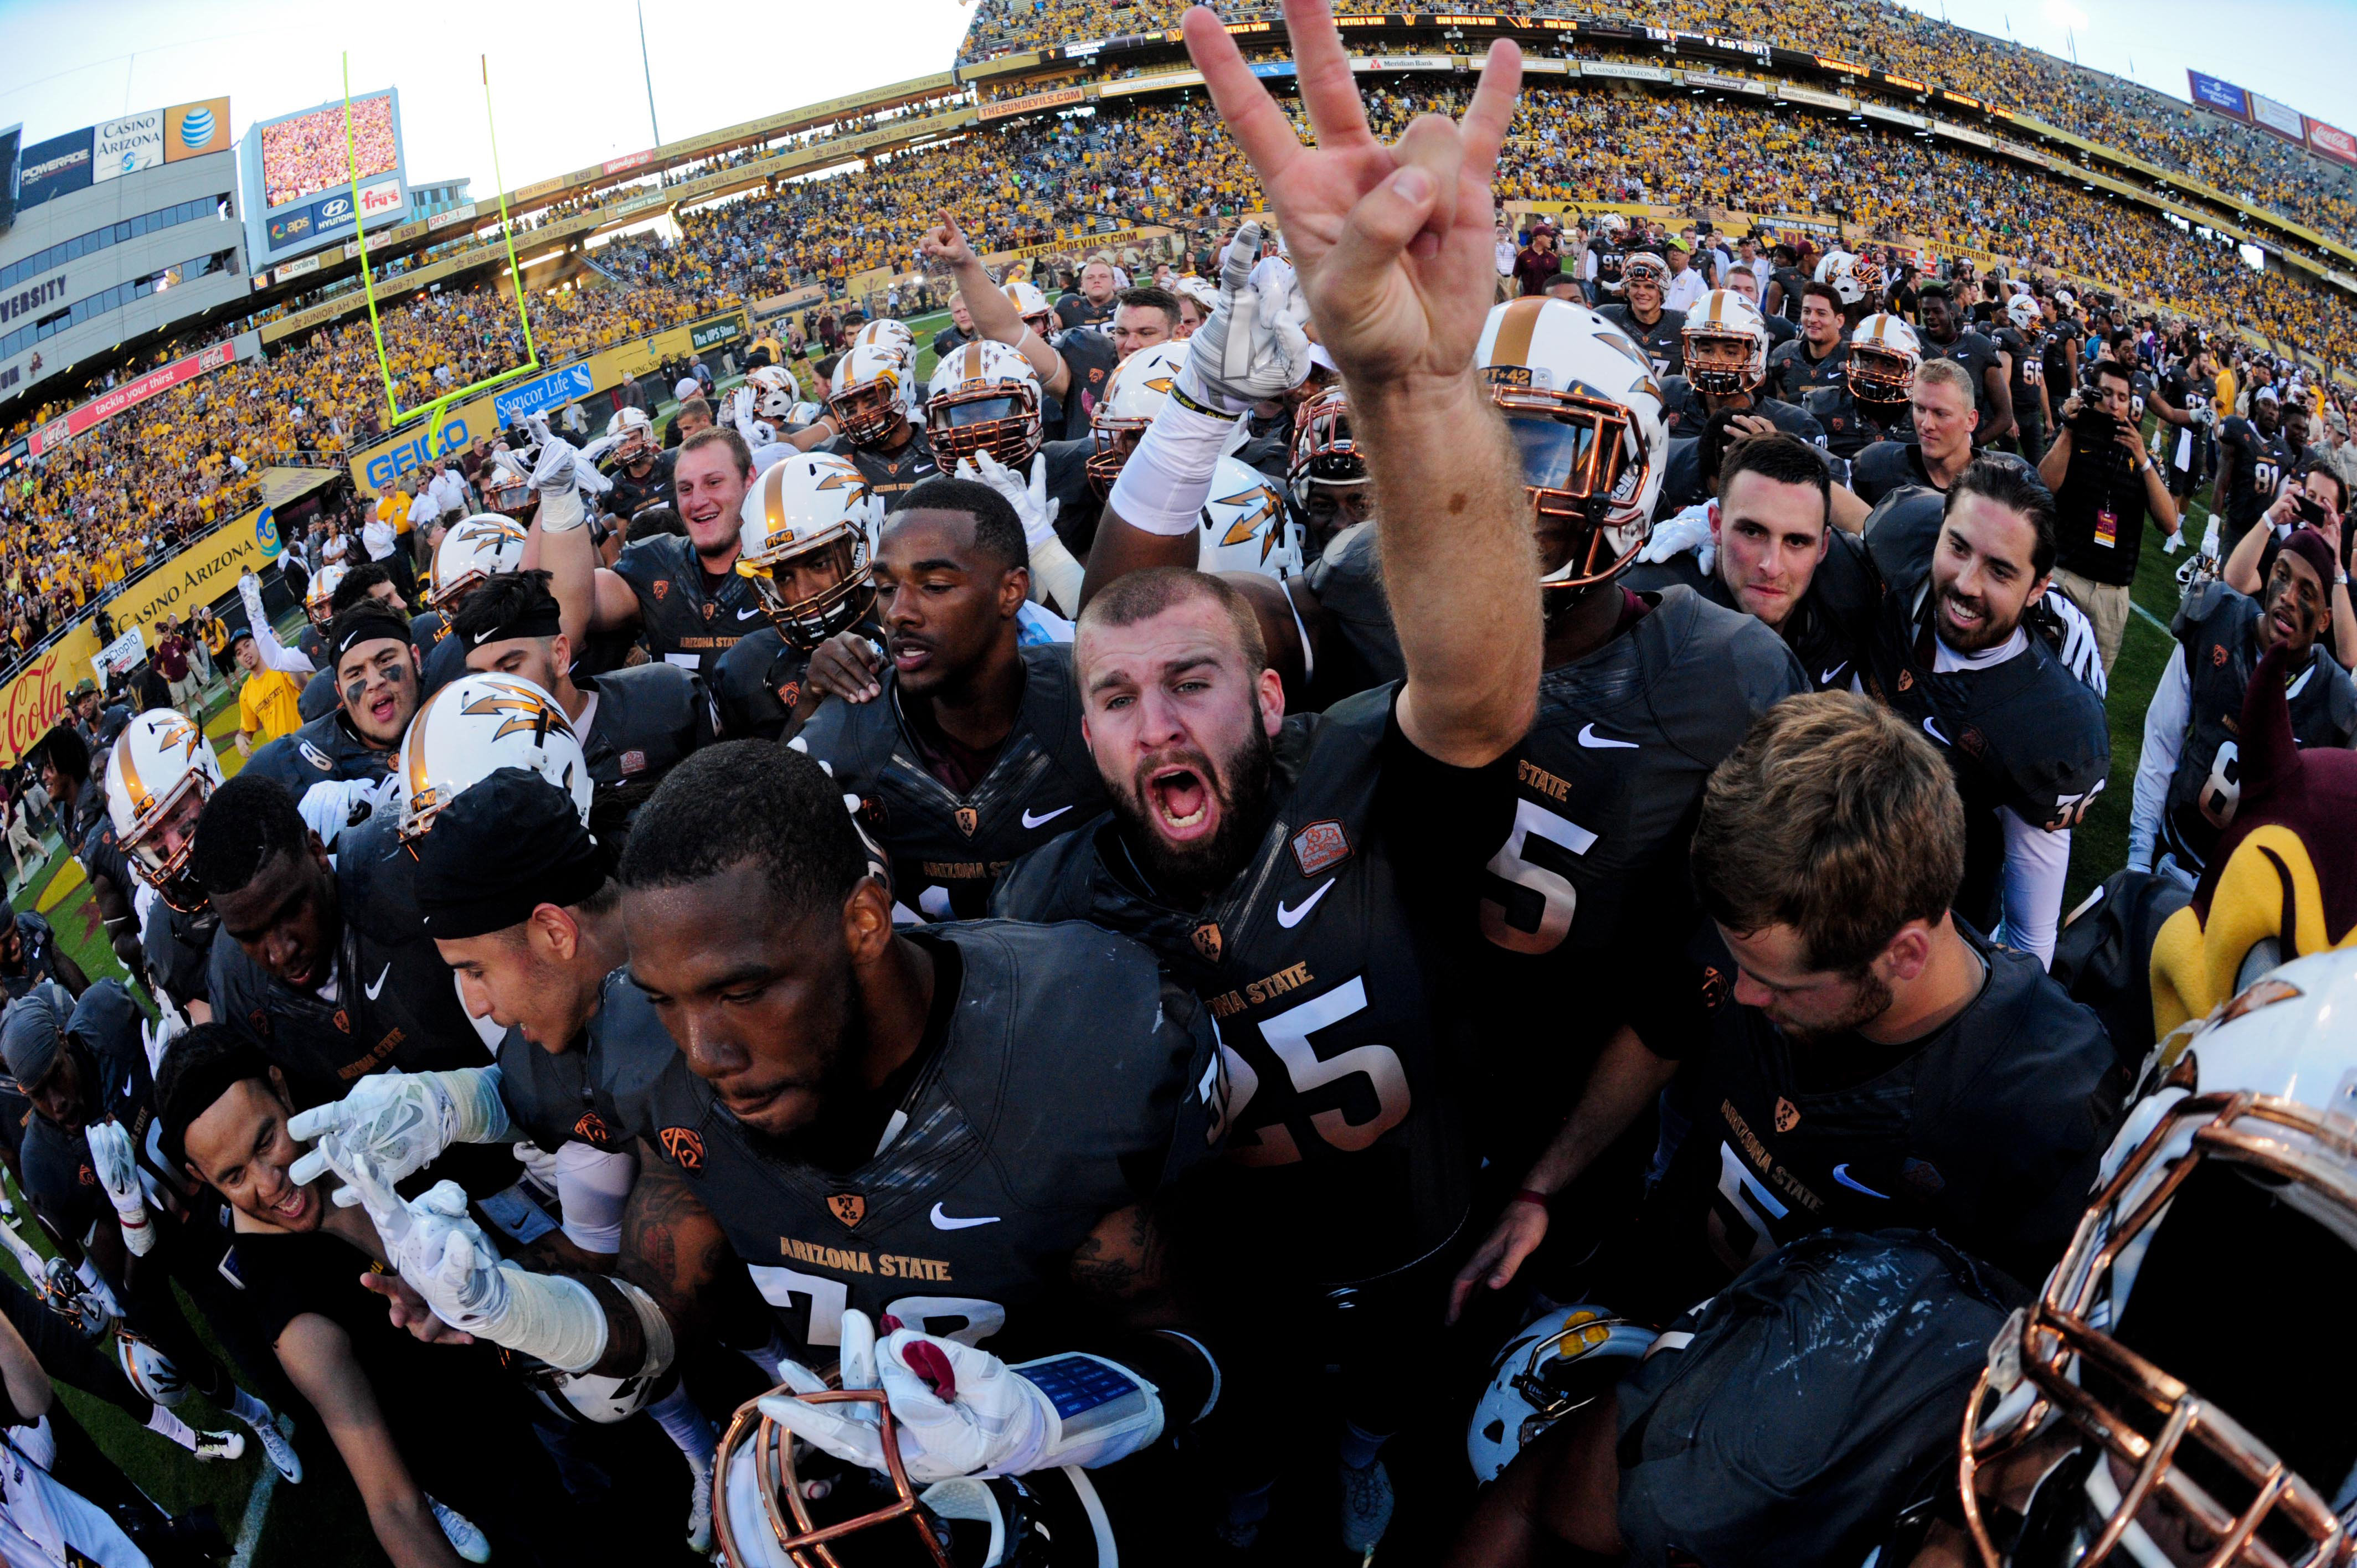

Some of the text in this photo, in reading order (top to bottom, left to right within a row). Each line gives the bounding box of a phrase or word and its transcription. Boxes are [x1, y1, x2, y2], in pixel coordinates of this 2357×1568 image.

[1250, 22, 1270, 32] WIN!
[1435, 16, 1496, 25] SUN DEVILS WIN!
[1544, 20, 1558, 29] SUN
[1066, 41, 1105, 52] COLORADO
[1718, 39, 1736, 49] 0:00
[1584, 64, 1659, 79] CASINO ARIZONA
[865, 85, 911, 99] RICHARDSON
[1130, 79, 1176, 89] bluemedia
[1686, 75, 1742, 89] ValleyMetro.org
[981, 90, 1080, 118] THESUNDEVILS.COM
[1780, 89, 1830, 104] midfirst.com/asu
[104, 117, 155, 138] CASINO
[770, 114, 796, 125] HARRIS
[97, 132, 160, 157] ARIZONA
[662, 145, 681, 154] LEON
[683, 137, 711, 149] BURTON
[826, 121, 942, 154] JIM JEFFCOAT 1979-82
[21, 148, 90, 182] POWERADE
[607, 157, 635, 173] Wendy's
[574, 171, 591, 183] ASU
[697, 161, 780, 190] JD HILL 1967-70
[534, 179, 560, 193] TICKETS?
[361, 190, 399, 210] fry's
[287, 216, 310, 233] aps
[318, 211, 355, 229] HYUNDAI
[400, 227, 416, 240] ASU
[467, 222, 579, 265] BOB BRENIG 1972-74
[1018, 231, 1138, 259] THESUDEVILS.COM
[279, 257, 317, 276] ASU online
[303, 307, 334, 324] JUNIOR
[337, 301, 350, 312] AH
[382, 278, 415, 298] 1969-71
[693, 325, 736, 346] The UPS Store
[198, 347, 224, 371] Coca-Cola
[2023, 360, 2044, 386] 66
[95, 371, 174, 415] tackle your thirst
[496, 372, 569, 419] Sagicor Life
[1180, 396, 1196, 411] devil
[41, 419, 70, 450] Coca-Cola
[366, 419, 469, 489] GEICO
[2255, 463, 2279, 497] 81
[118, 540, 255, 636] CASINO ARIZONA
[680, 636, 742, 648] ARIZONA STAT
[1517, 759, 1572, 802] STATE
[923, 860, 987, 879] ARIZONA
[1249, 960, 1315, 1005] STATE
[374, 1027, 406, 1059] STATE
[660, 1126, 703, 1157] PAC
[677, 1149, 702, 1169] 12
[1721, 1097, 1825, 1215] ARIZONA STATE
[780, 1236, 953, 1282] ARIZONA STATE
